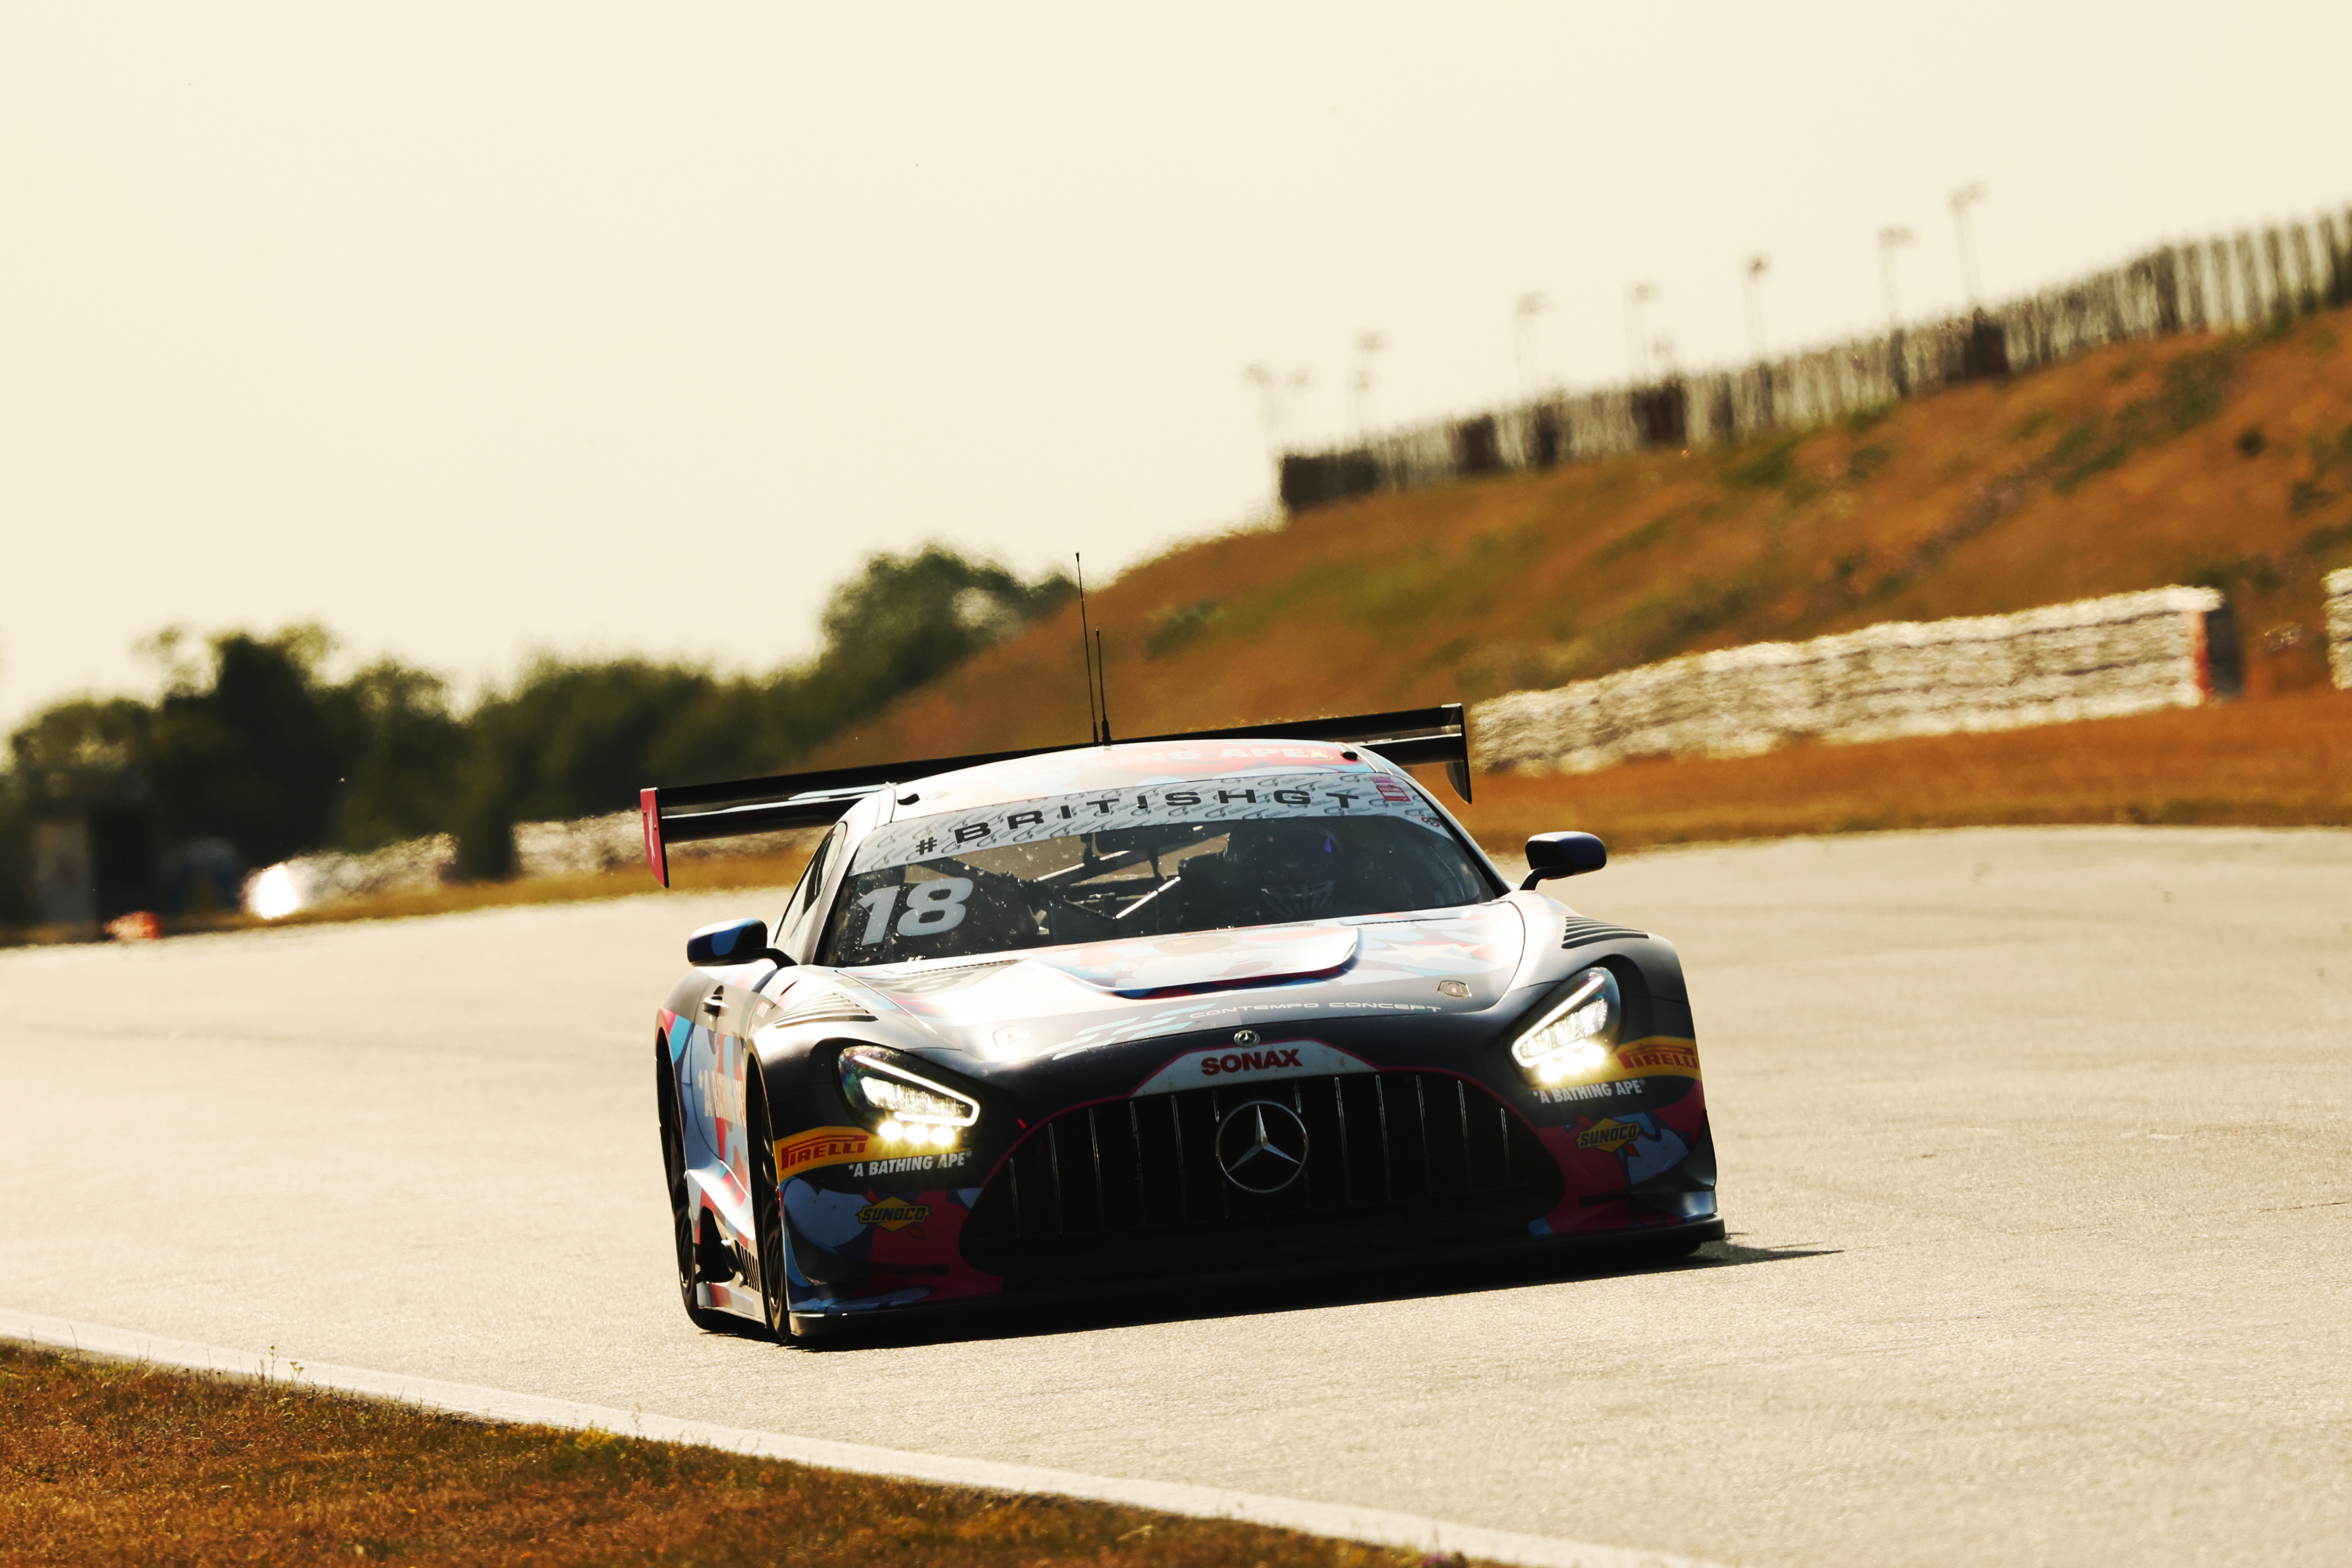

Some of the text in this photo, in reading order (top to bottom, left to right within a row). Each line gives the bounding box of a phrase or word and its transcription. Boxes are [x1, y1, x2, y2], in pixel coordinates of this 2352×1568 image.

[857, 877, 973, 946] 18
[1189, 1002, 1441, 1018] CONTEMPO CONCEPT
[1201, 1048, 1303, 1076] SONAX
[1617, 1045, 1698, 1069] PIRELLI
[1551, 1083, 1612, 1103] BATHING
[1581, 1124, 1637, 1146] SUNOCO
[781, 1135, 869, 1170] PIRELLI
[869, 1156, 933, 1176] BATHING
[863, 1207, 927, 1221] SUNOCO
